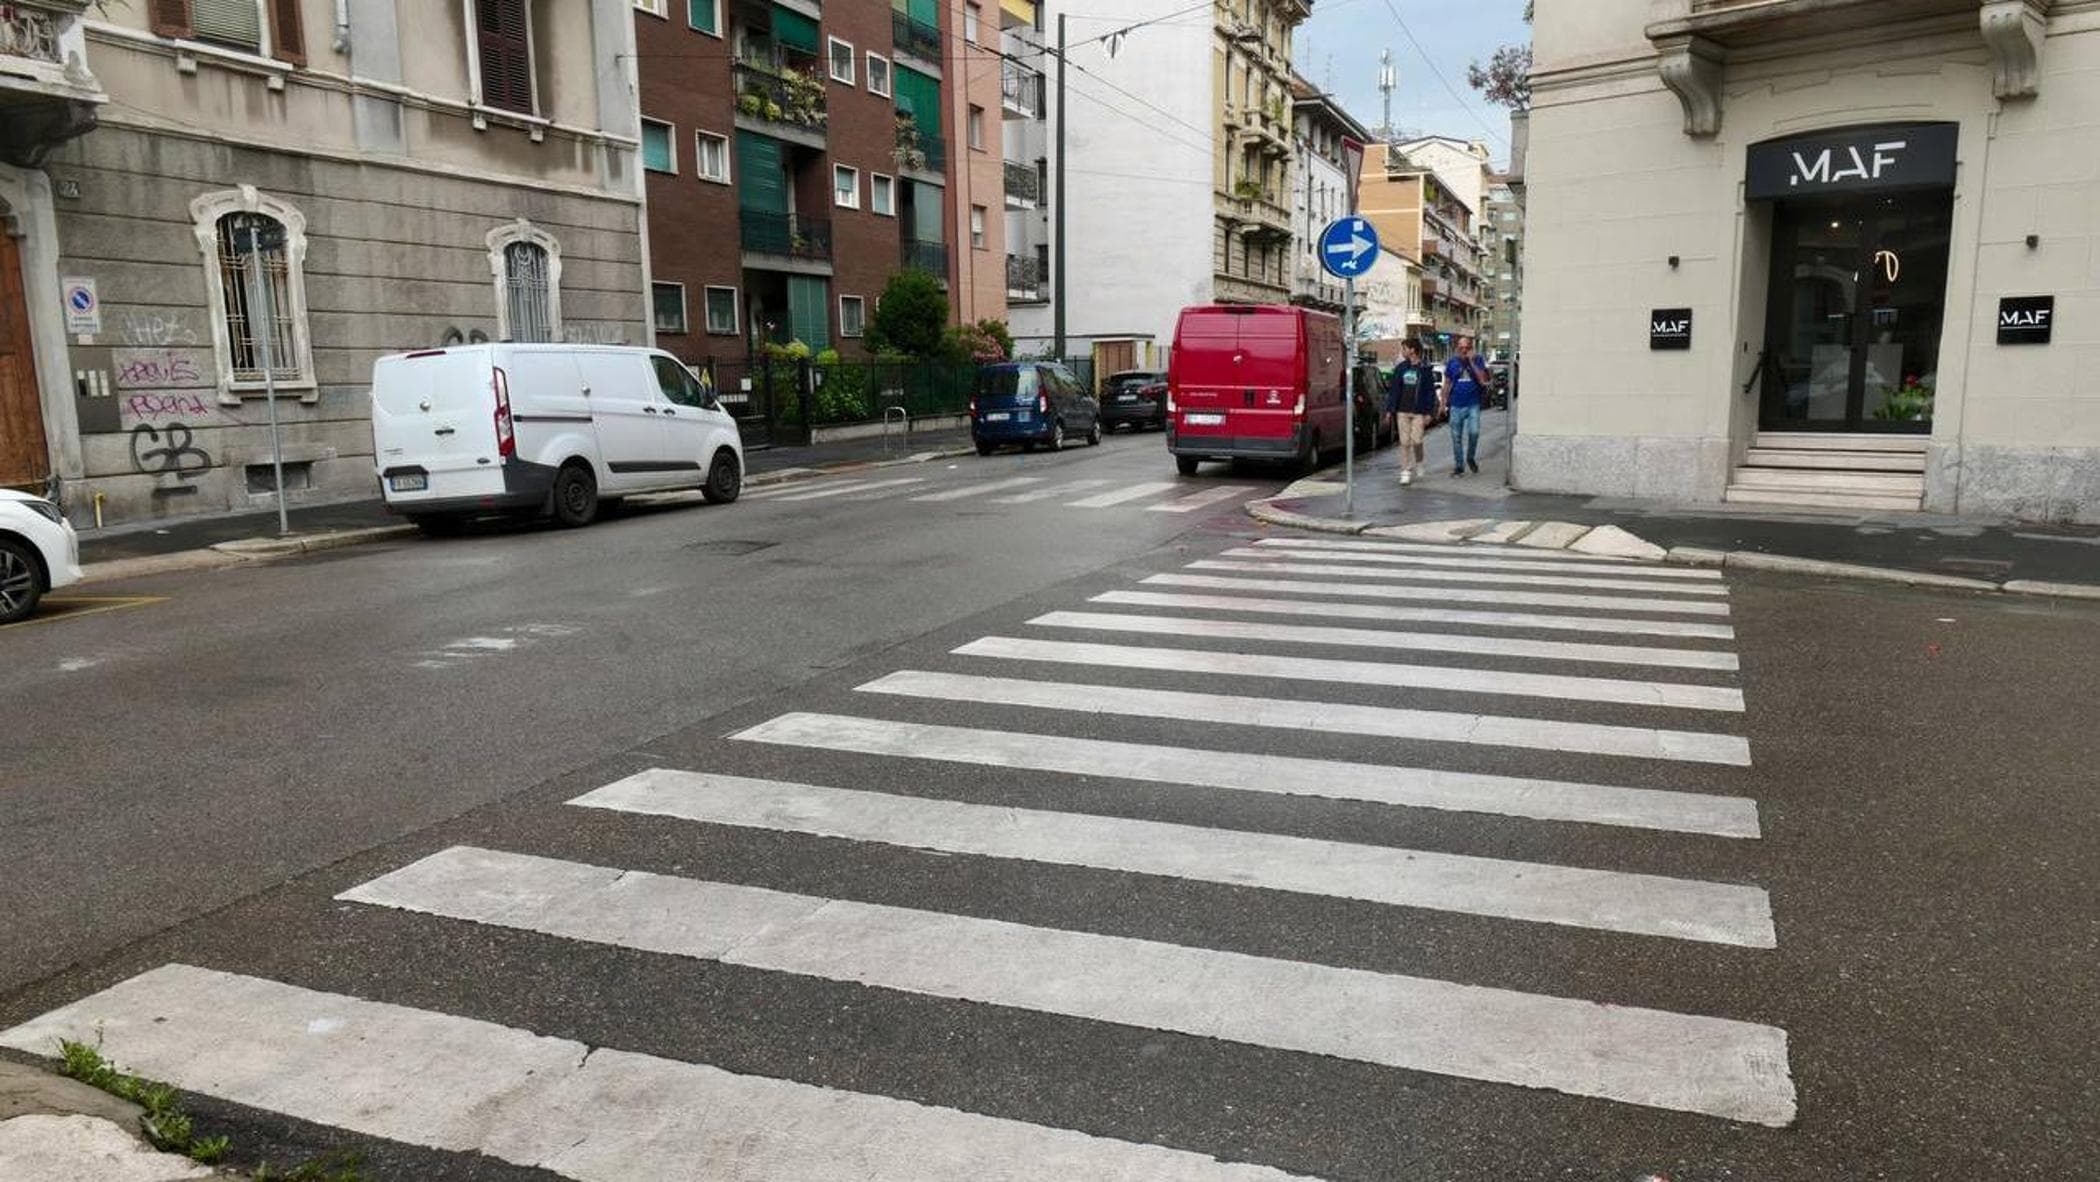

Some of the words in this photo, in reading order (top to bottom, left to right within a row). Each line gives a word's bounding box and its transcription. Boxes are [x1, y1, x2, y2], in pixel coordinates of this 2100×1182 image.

[1790, 141, 1907, 185] MAF
[2000, 310, 2050, 325] MAF
[1652, 320, 1689, 333] MAF
